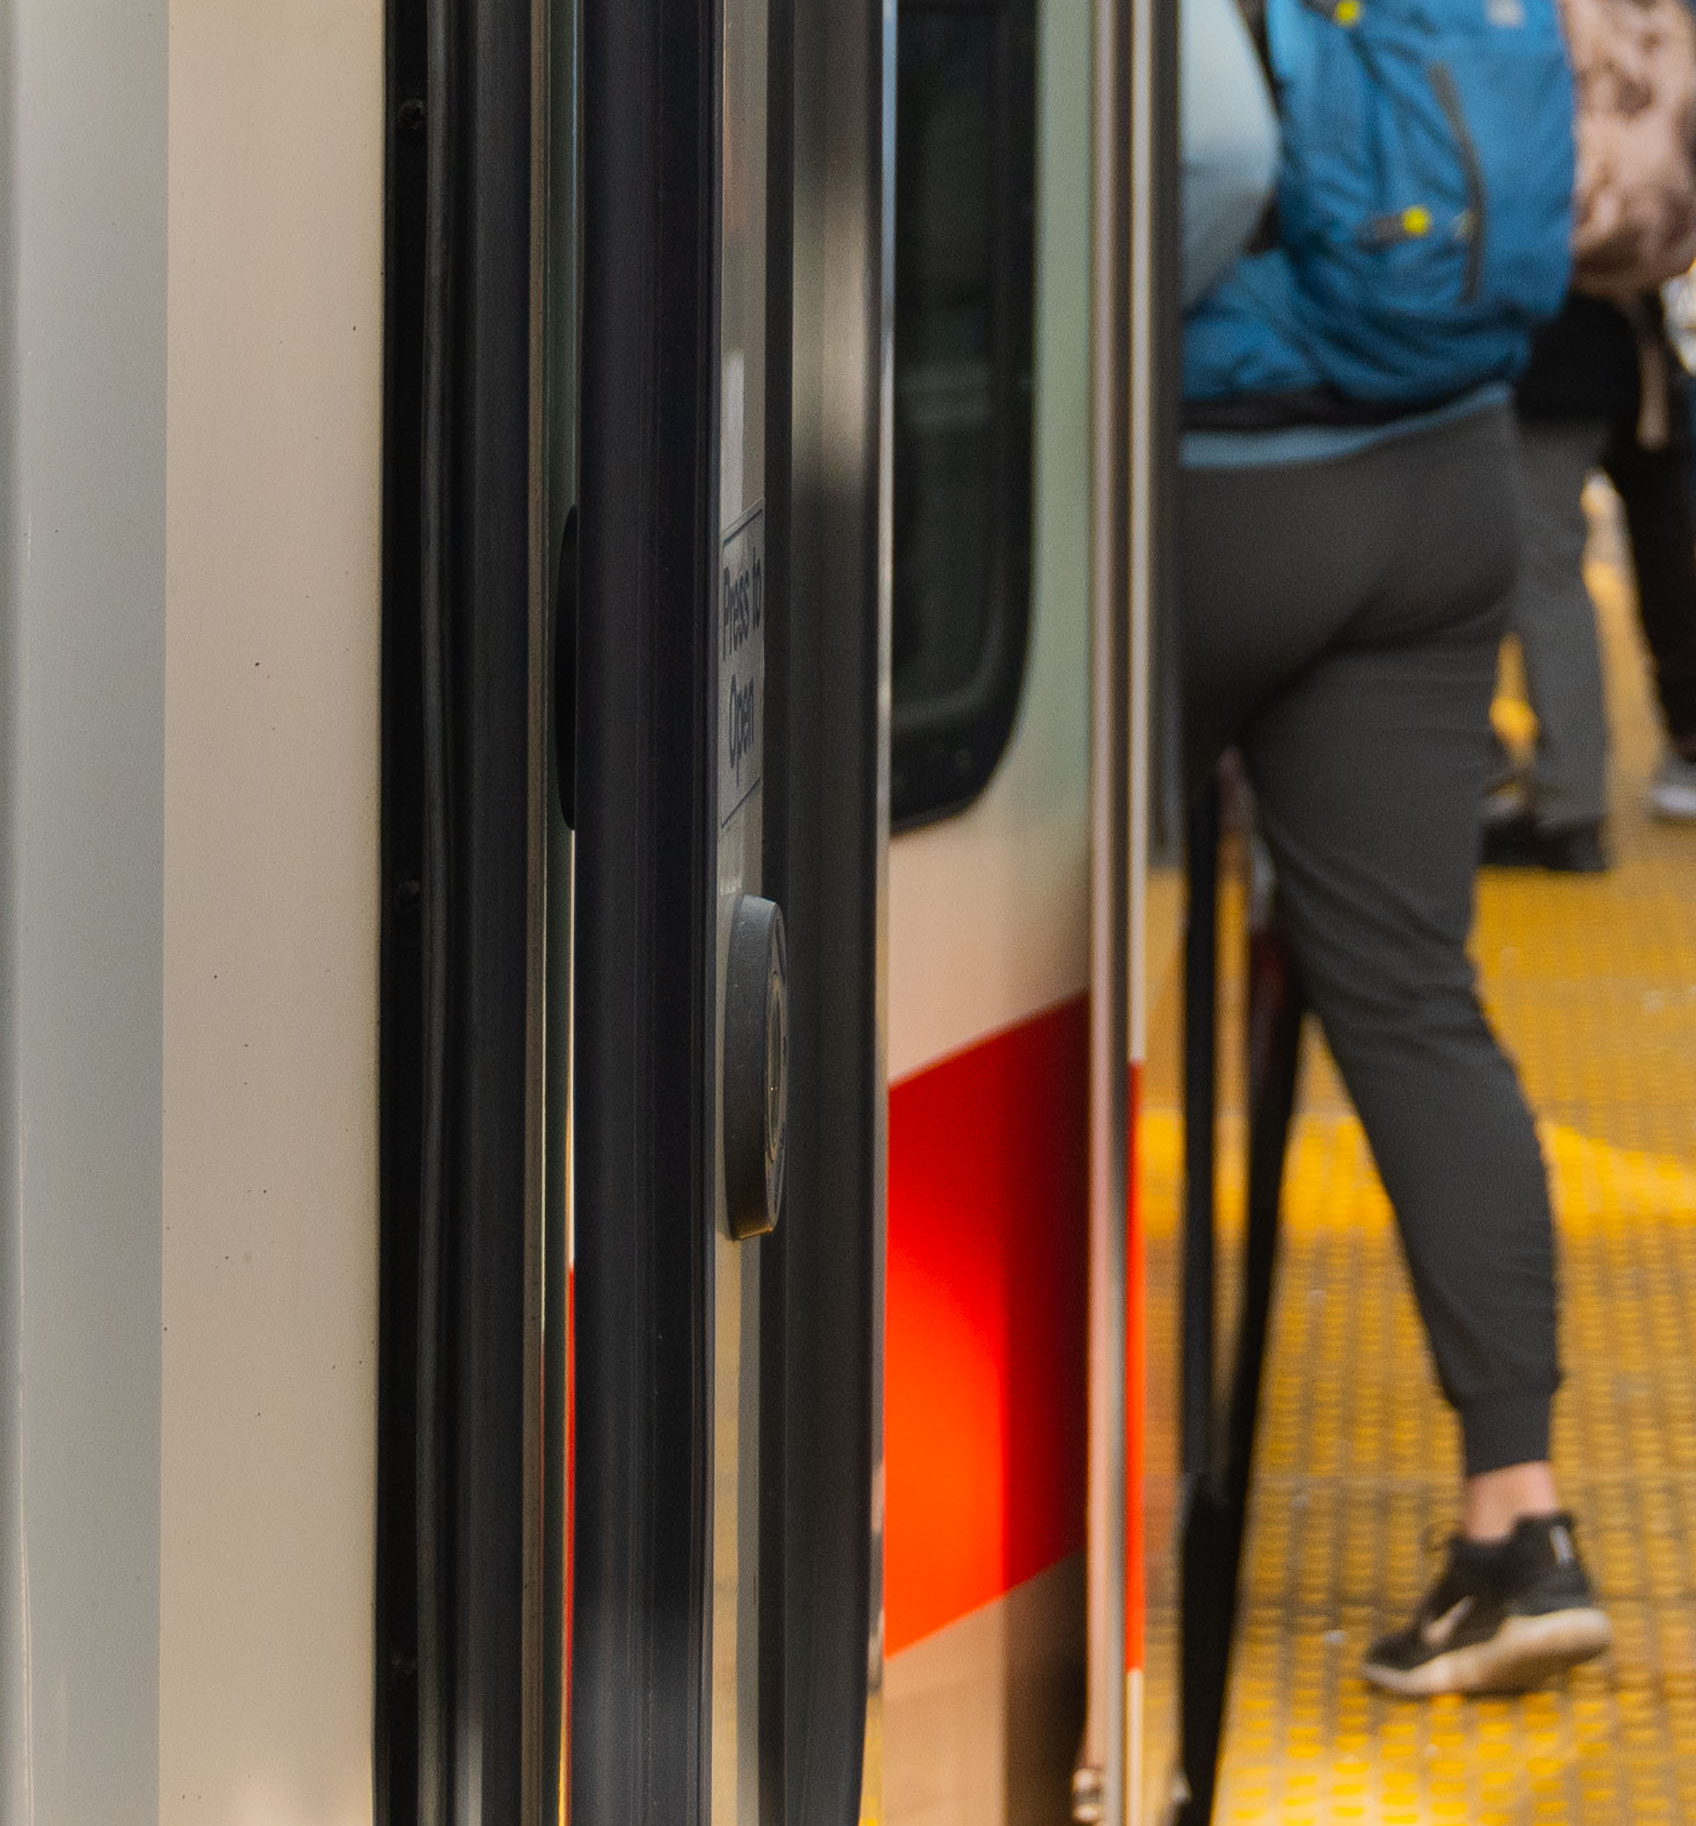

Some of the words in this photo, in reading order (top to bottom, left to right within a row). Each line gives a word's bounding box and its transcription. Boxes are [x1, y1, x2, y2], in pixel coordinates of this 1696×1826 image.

[722, 566, 750, 663] Press
[752, 545, 762, 632] to
[728, 673, 755, 788] Open
